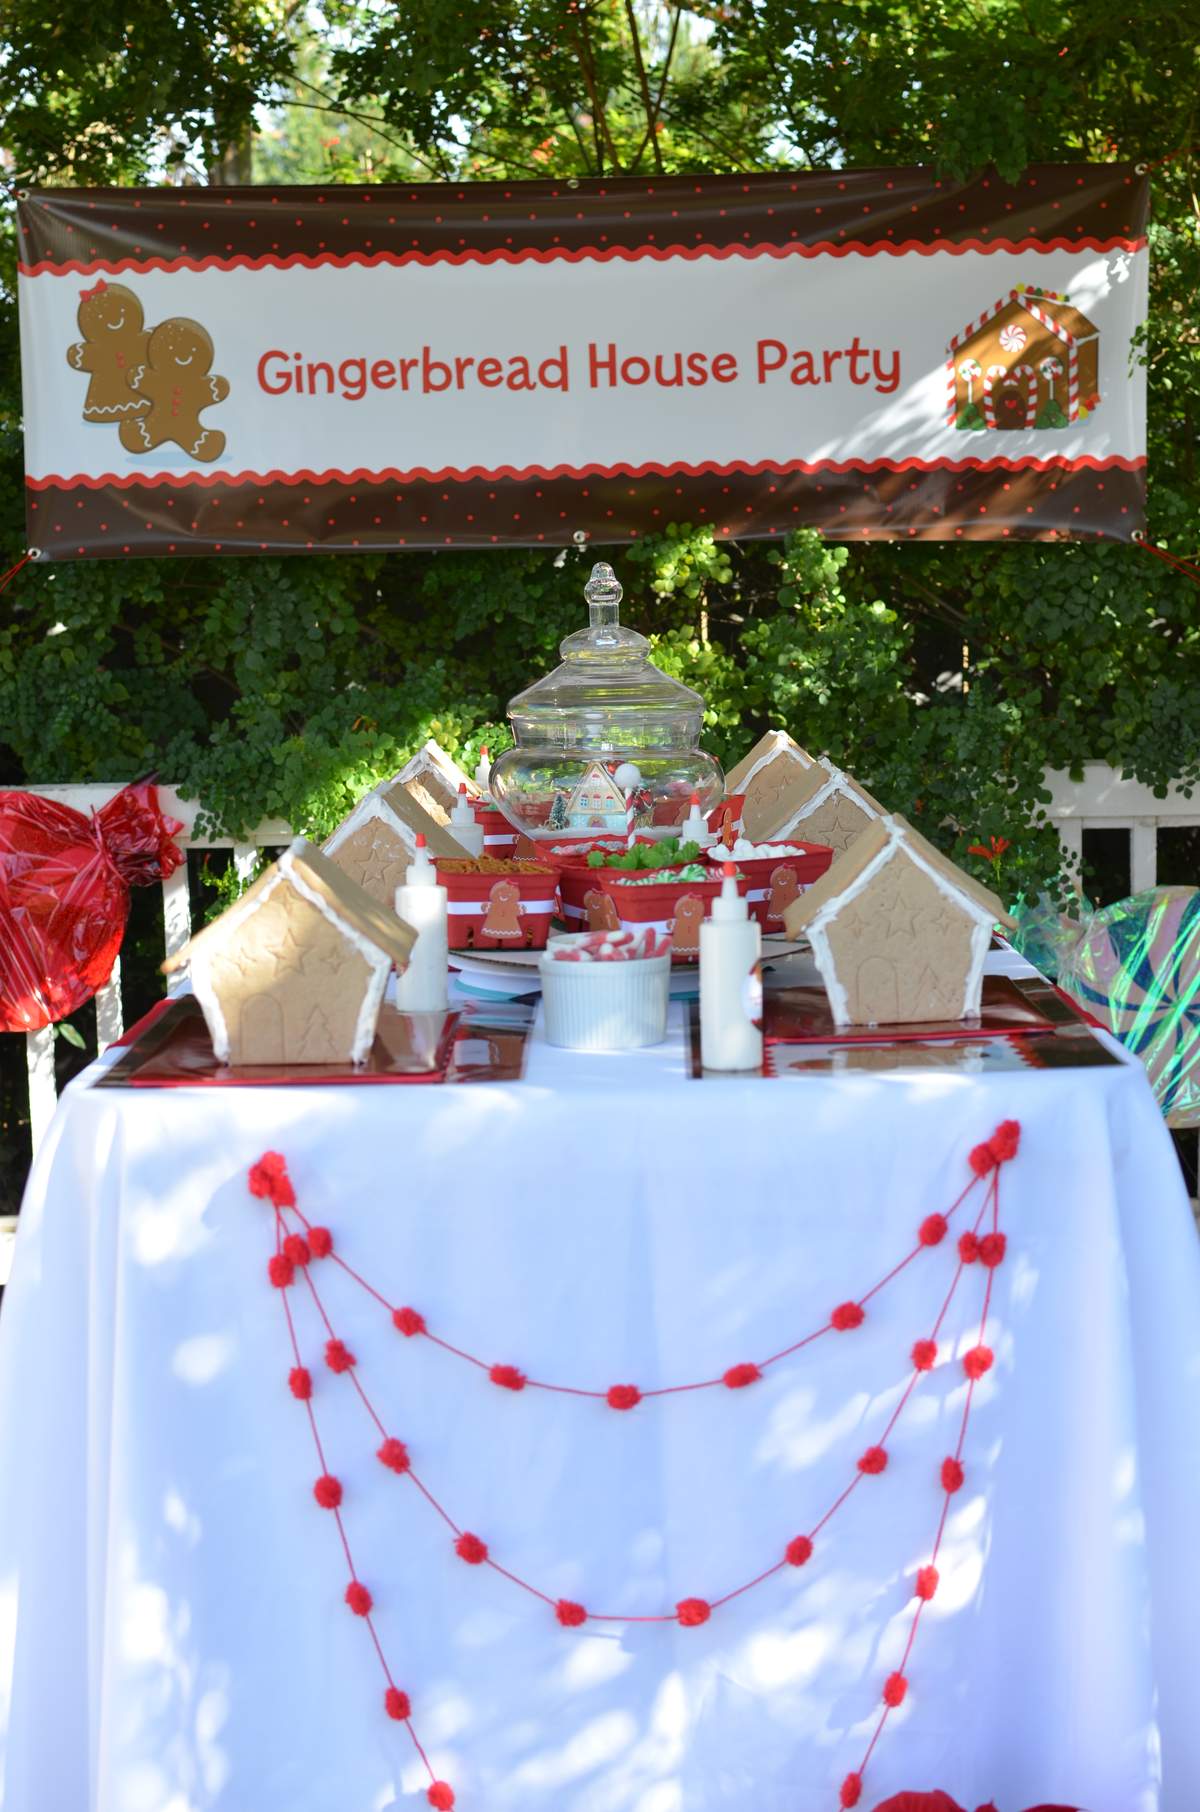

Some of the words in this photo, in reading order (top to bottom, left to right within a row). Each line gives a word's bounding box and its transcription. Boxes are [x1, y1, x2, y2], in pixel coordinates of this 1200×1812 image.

[257, 346, 570, 401] Gingerbread
[588, 343, 737, 388] House
[757, 337, 900, 394] Party
